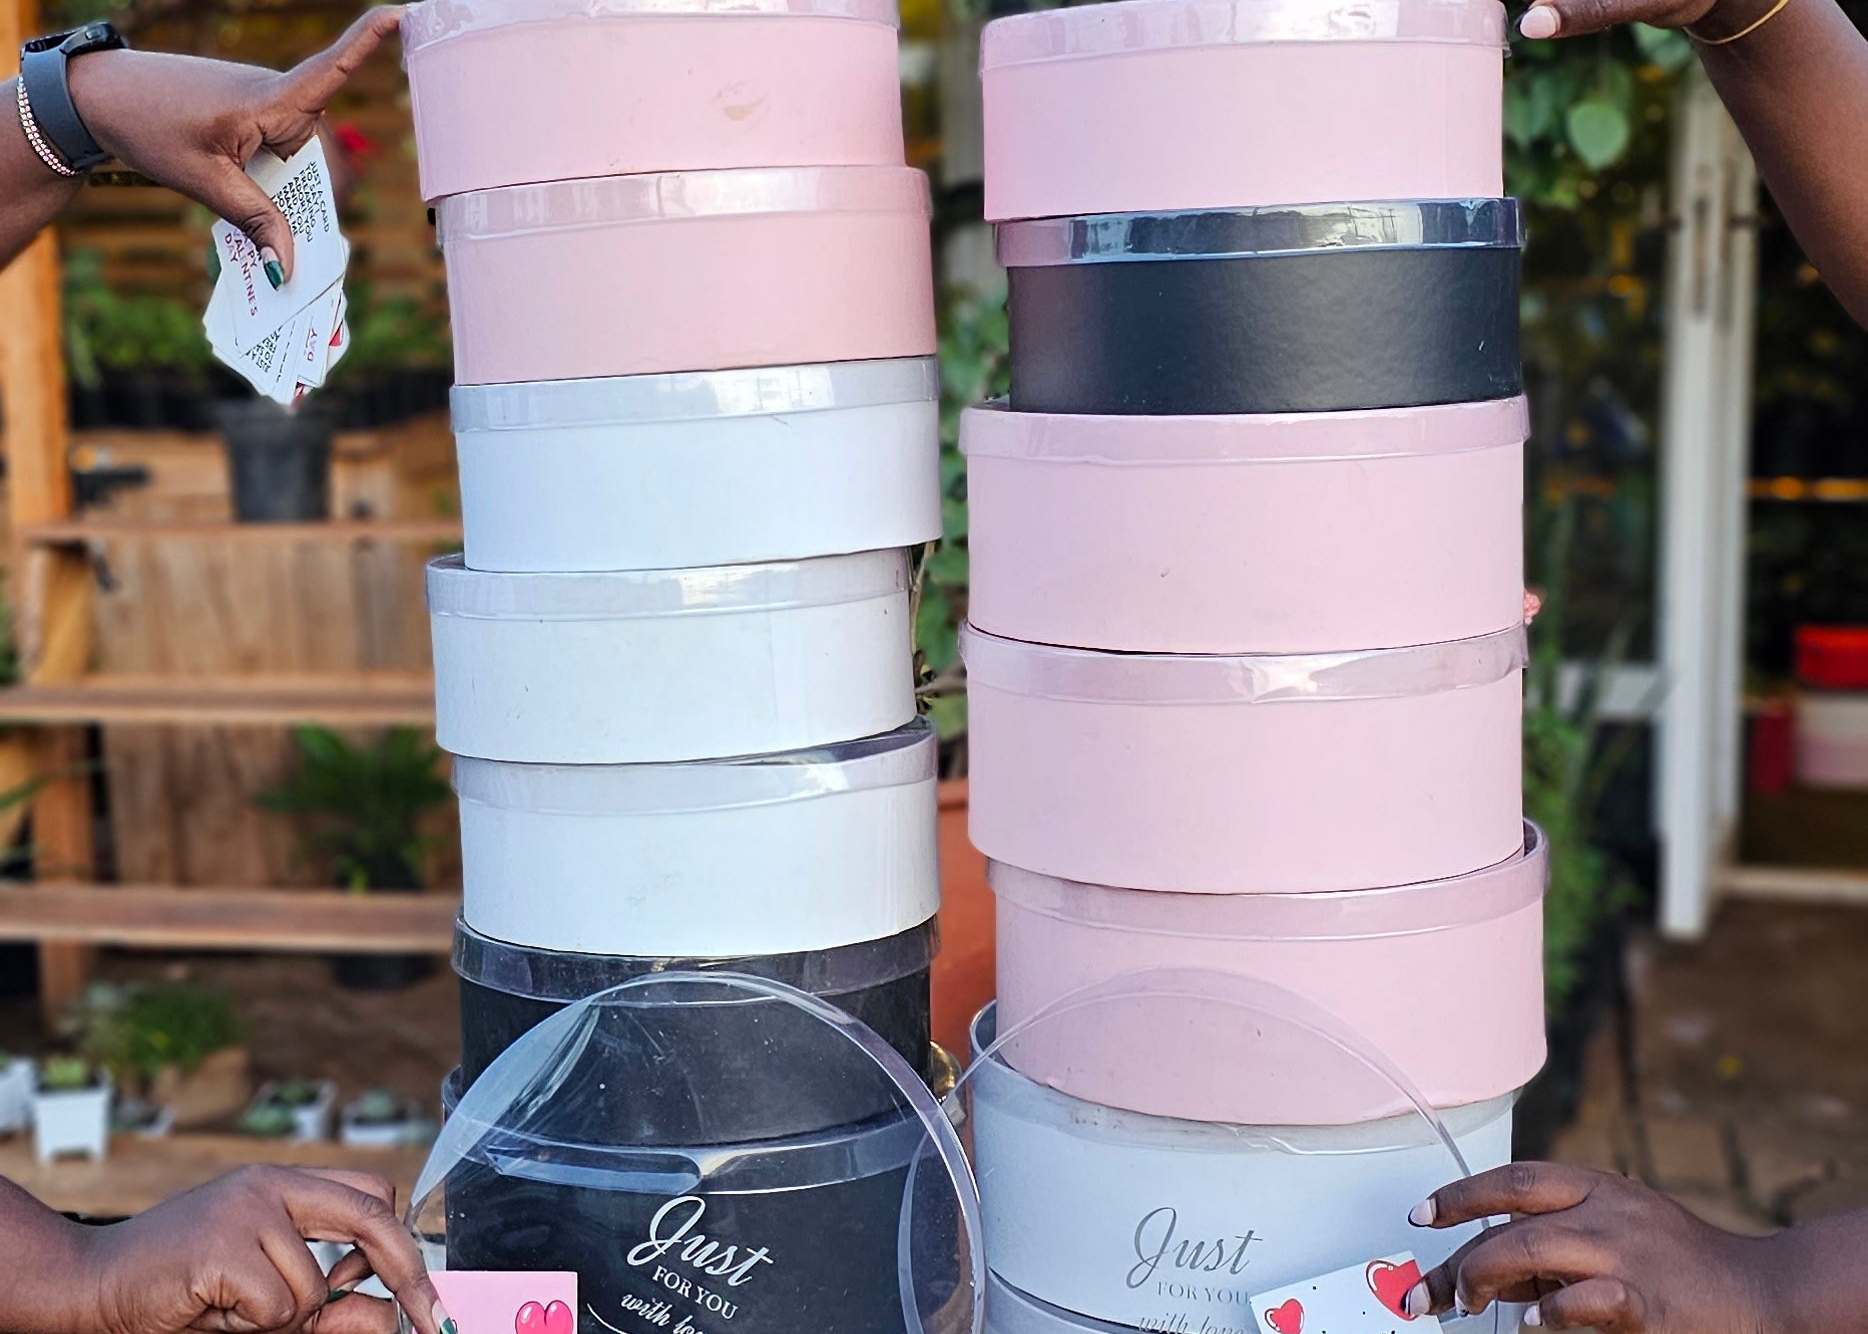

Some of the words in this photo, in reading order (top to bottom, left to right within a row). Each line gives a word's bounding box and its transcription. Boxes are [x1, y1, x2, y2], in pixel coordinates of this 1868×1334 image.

[627, 1195, 773, 1287] Just
[1126, 1207, 1263, 1289] Just
[621, 1291, 669, 1328] with
[652, 1265, 697, 1299] FOR
[696, 1285, 738, 1320] YOU
[1156, 1281, 1198, 1303] FOR
[1198, 1285, 1251, 1305] YOU
